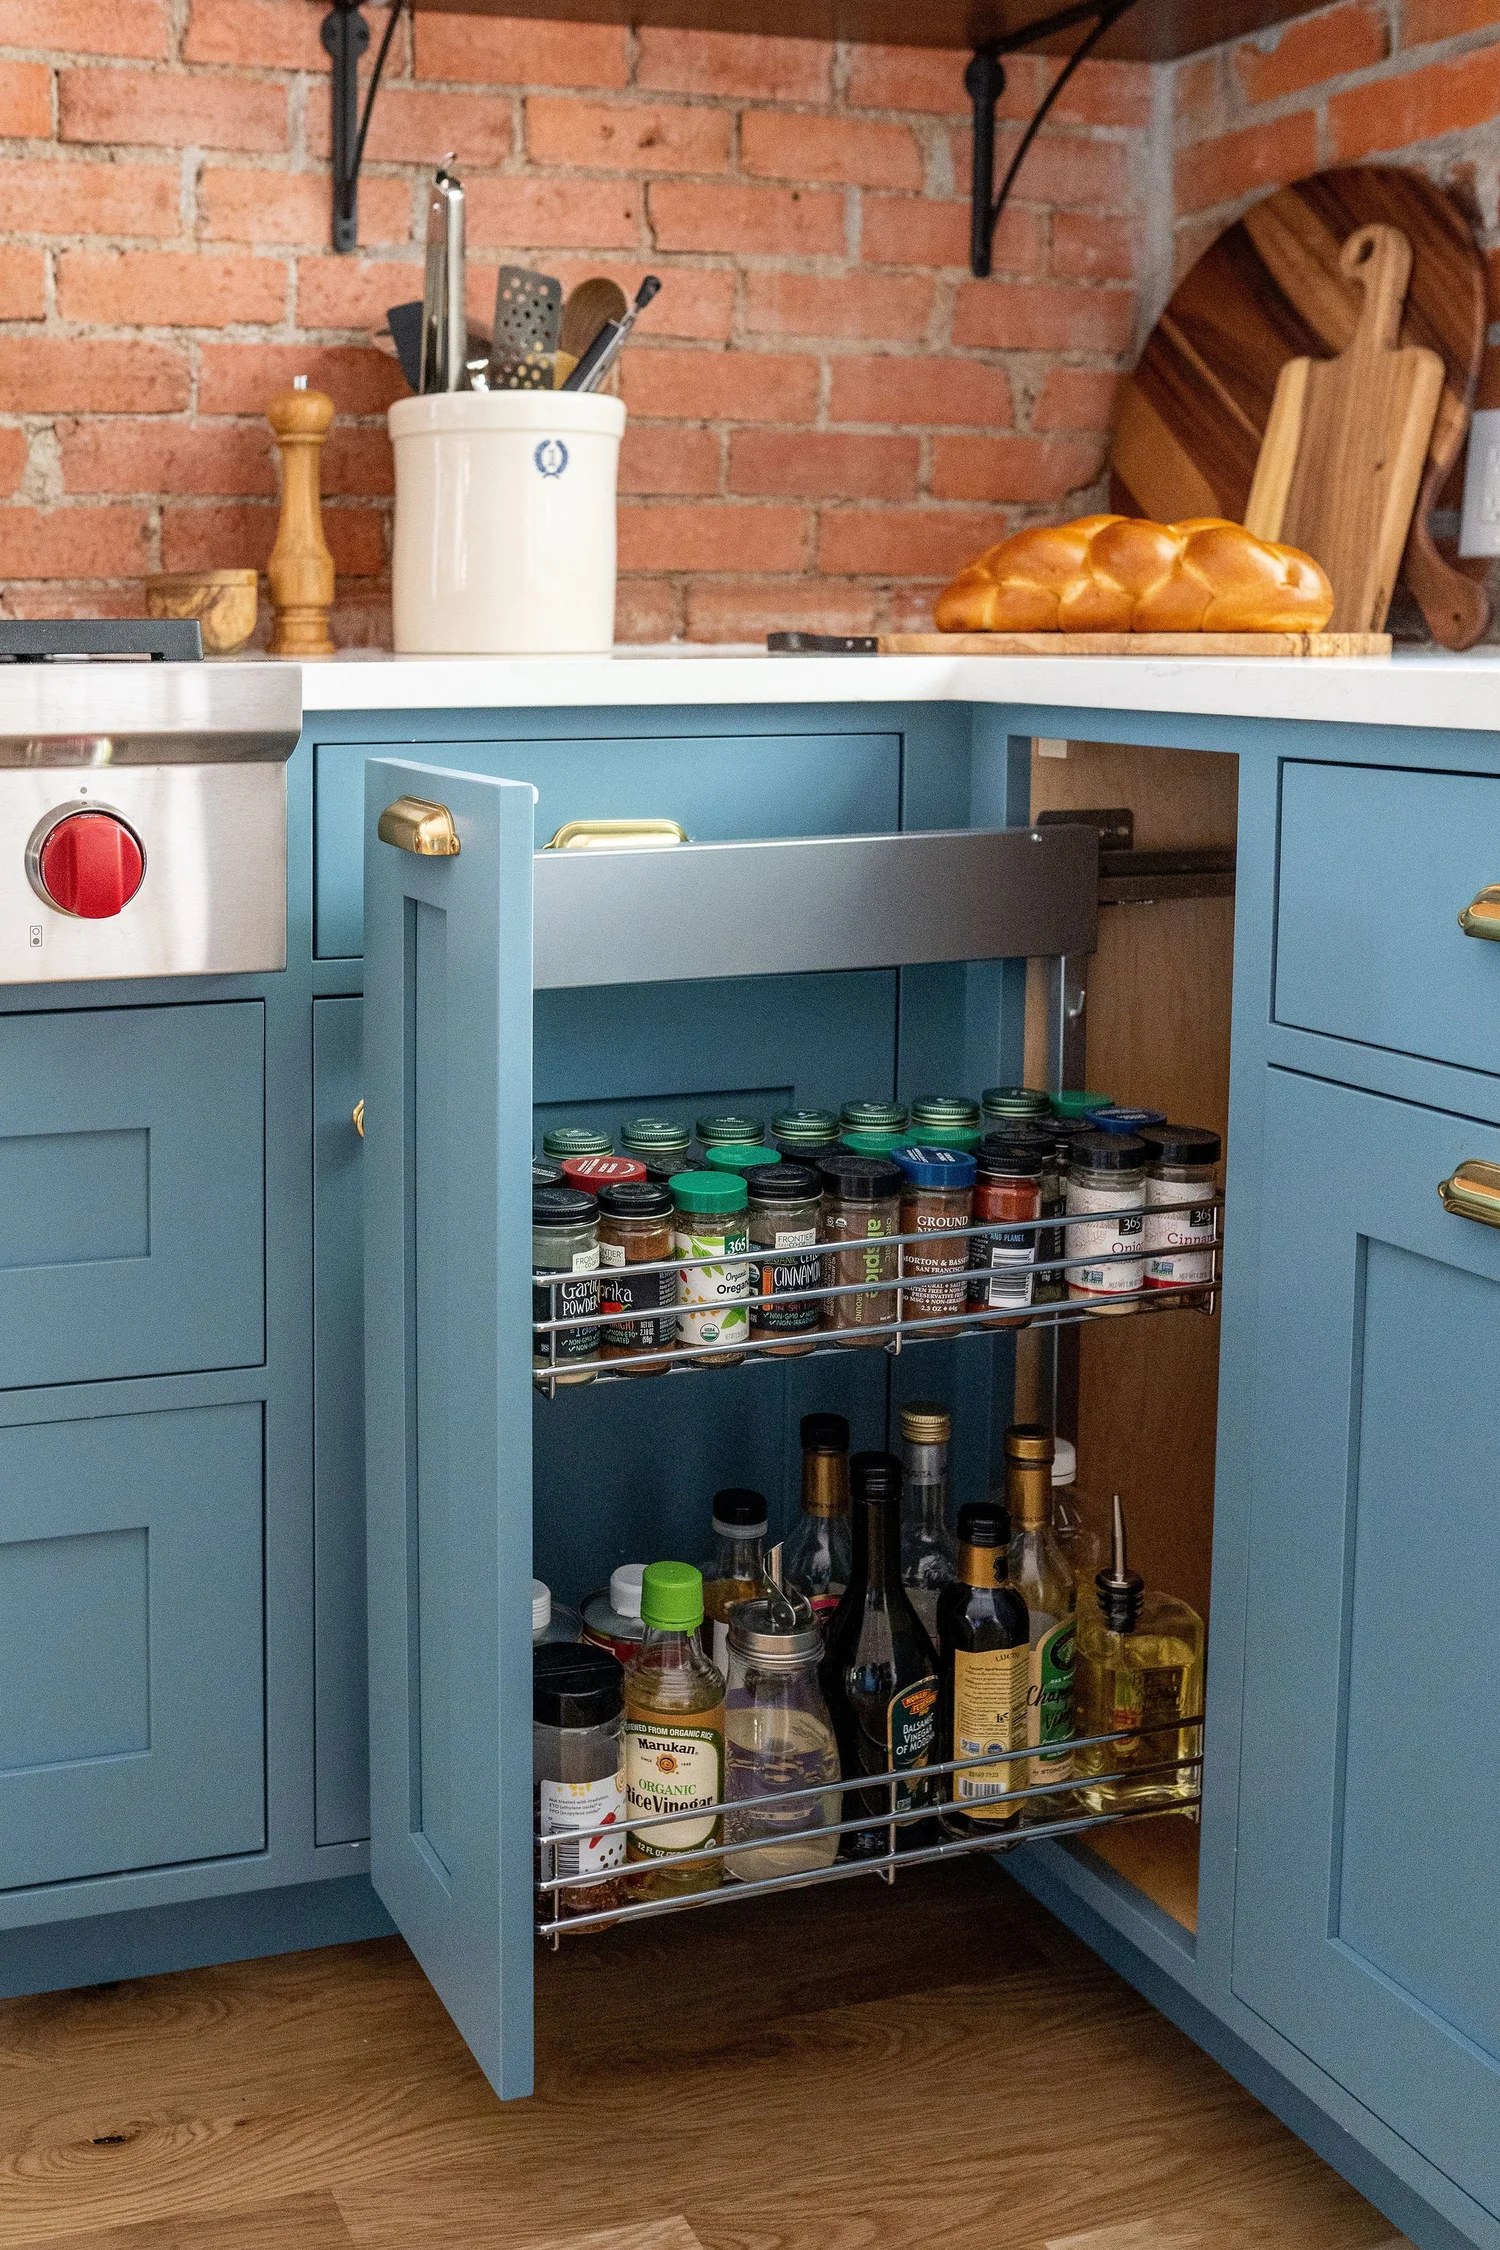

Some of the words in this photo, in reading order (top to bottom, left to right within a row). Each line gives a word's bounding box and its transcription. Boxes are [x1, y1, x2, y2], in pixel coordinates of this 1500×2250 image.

[916, 1215, 969, 1228] GROUND
[1194, 1209, 1211, 1223] 365
[1123, 1217, 1141, 1231] 365
[727, 1237, 746, 1254] 365
[647, 1726, 668, 1736] FROM
[669, 1728, 700, 1739] ORGANIC
[700, 1731, 714, 1740] RICE
[904, 1724, 933, 1744] VINEGAR
[637, 1737, 696, 1755] Marukan
[896, 1745, 908, 1756] OF
[638, 1779, 697, 1796] ORGANIC
[637, 1841, 646, 1851] 12
[645, 1845, 655, 1856] FL
